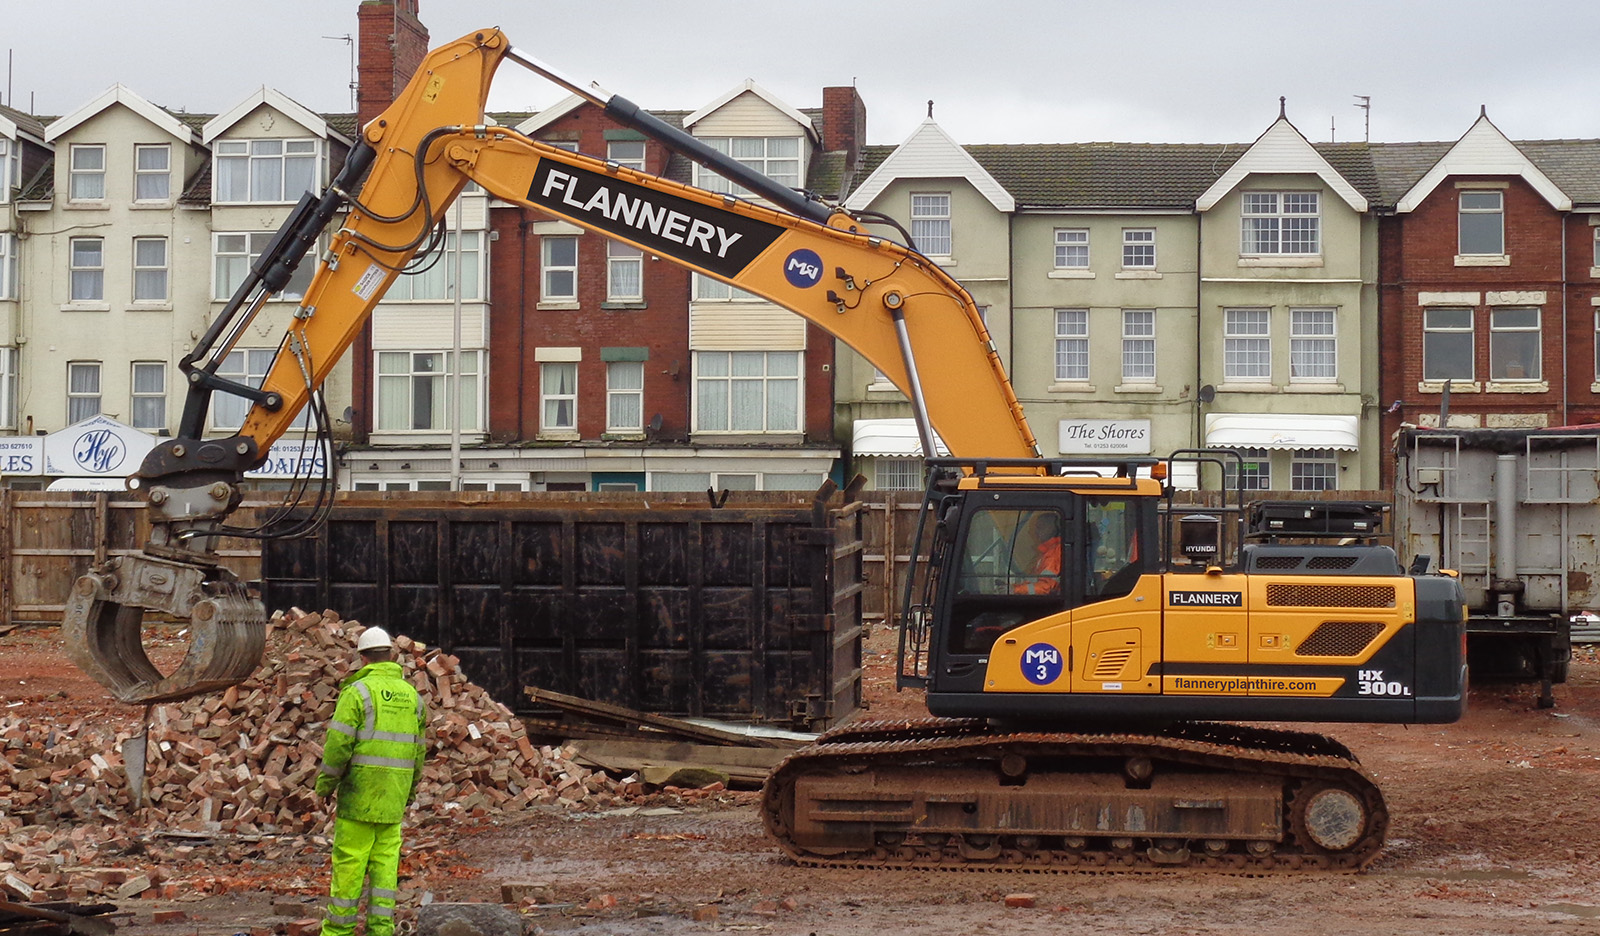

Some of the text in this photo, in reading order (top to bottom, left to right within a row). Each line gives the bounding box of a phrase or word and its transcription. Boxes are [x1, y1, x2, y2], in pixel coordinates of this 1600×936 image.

[541, 168, 743, 258] FLANNERY
[1067, 423, 1145, 440] The Shores
[1185, 545, 1216, 553] HYUNDAI
[1172, 593, 1239, 605] FLANNERY
[1036, 665, 1047, 680] 3
[1358, 670, 1384, 681] HX
[1175, 677, 1316, 692] flanneryplanthire.com
